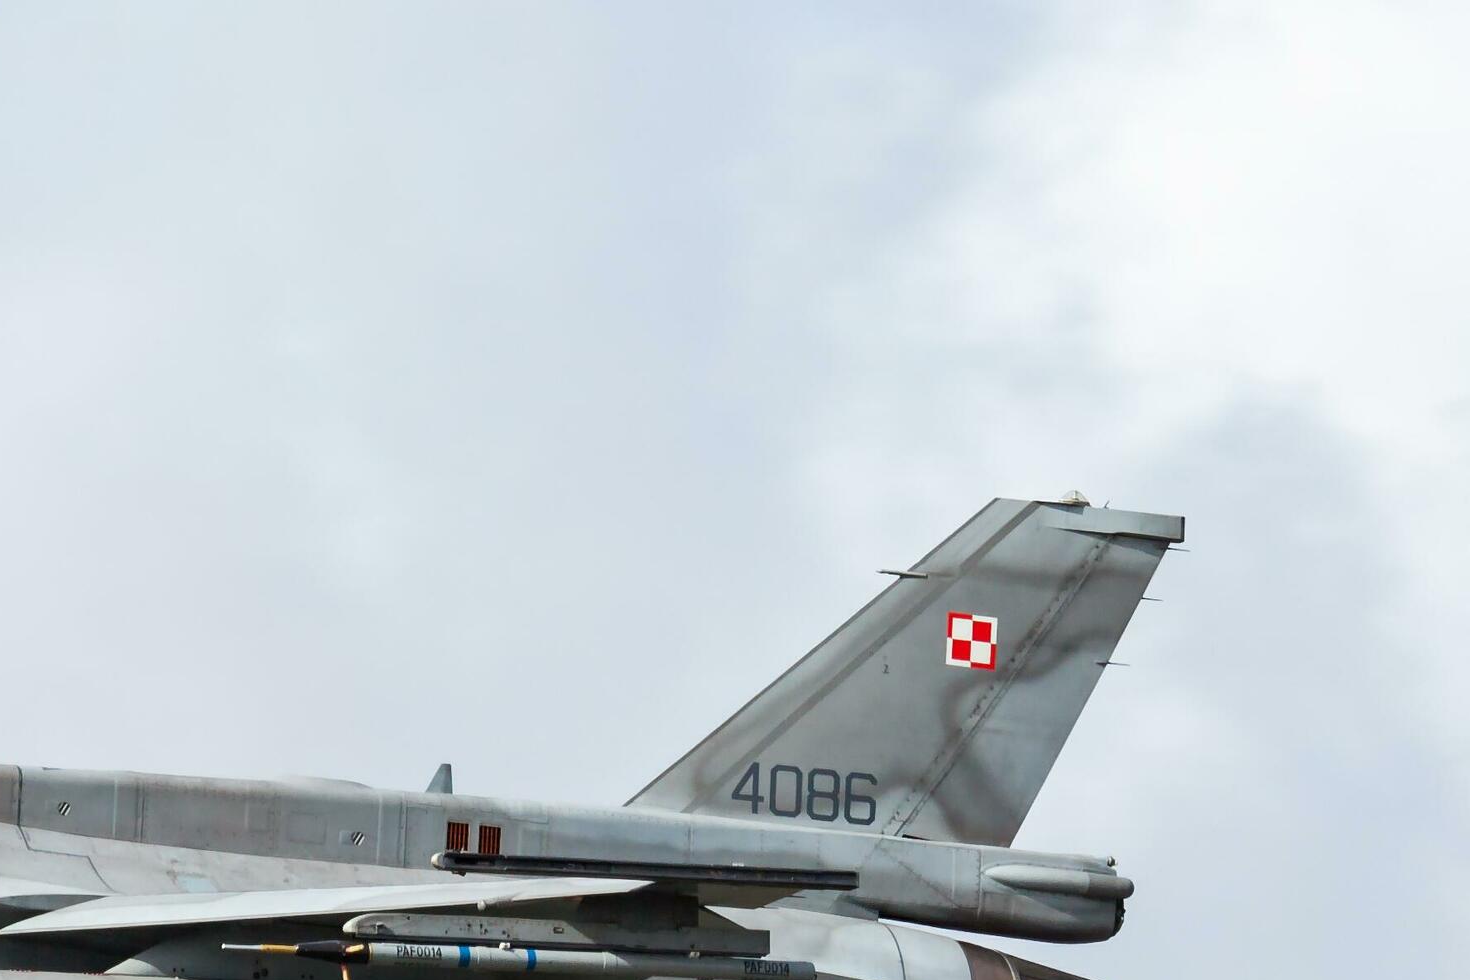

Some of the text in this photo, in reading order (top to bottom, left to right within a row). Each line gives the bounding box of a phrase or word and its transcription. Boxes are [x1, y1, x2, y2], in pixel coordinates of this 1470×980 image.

[731, 761, 878, 826] 4086
[396, 945, 443, 960] PAF0014
[744, 961, 790, 977] PAF0014
